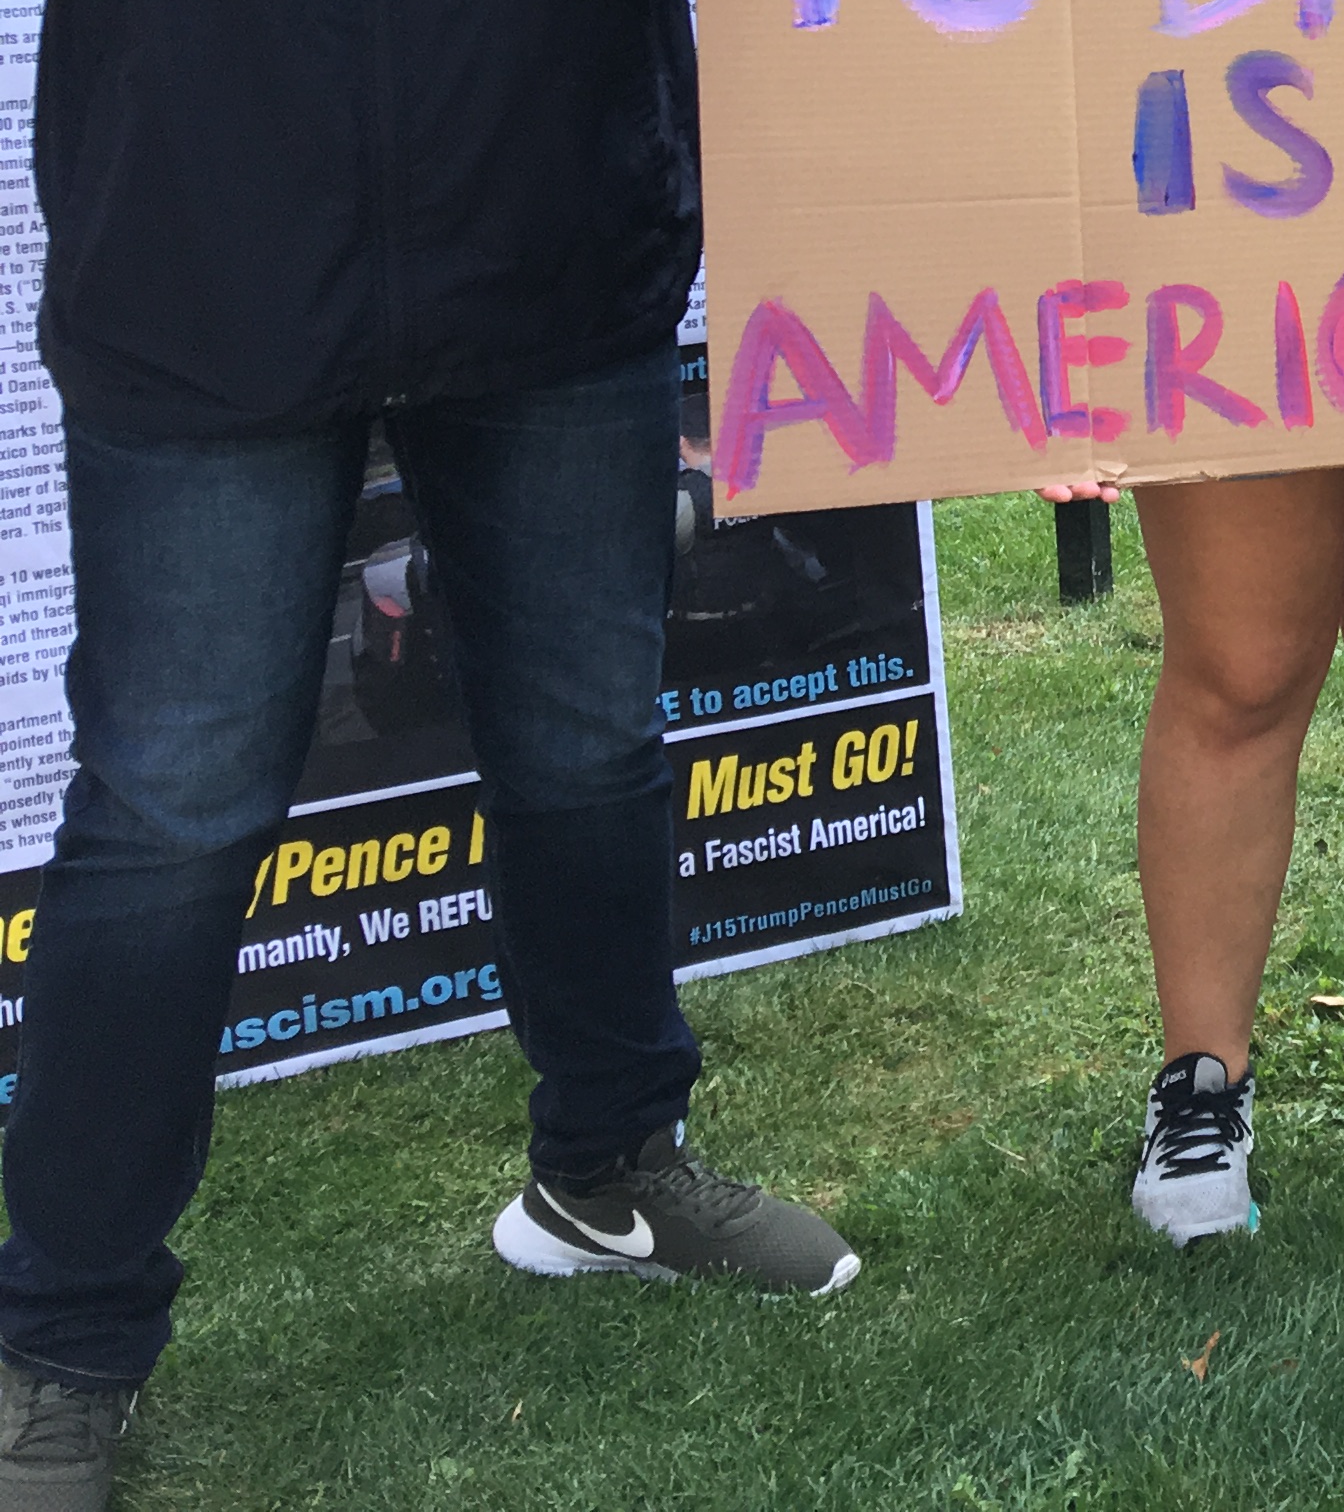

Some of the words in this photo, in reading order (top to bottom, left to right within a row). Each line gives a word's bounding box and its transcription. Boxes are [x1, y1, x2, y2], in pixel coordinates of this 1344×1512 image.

[1133, 50, 1334, 220] IS
[33, 666, 49, 683] by
[692, 690, 723, 716] to
[733, 664, 837, 710] accept
[847, 654, 914, 690] this.
[687, 742, 816, 820] Must
[832, 719, 919, 791] GO!
[11, 810, 57, 830] whose
[679, 852, 696, 877] a
[706, 823, 801, 873] Fascist
[810, 796, 926, 851] America!
[359, 907, 410, 945] We
